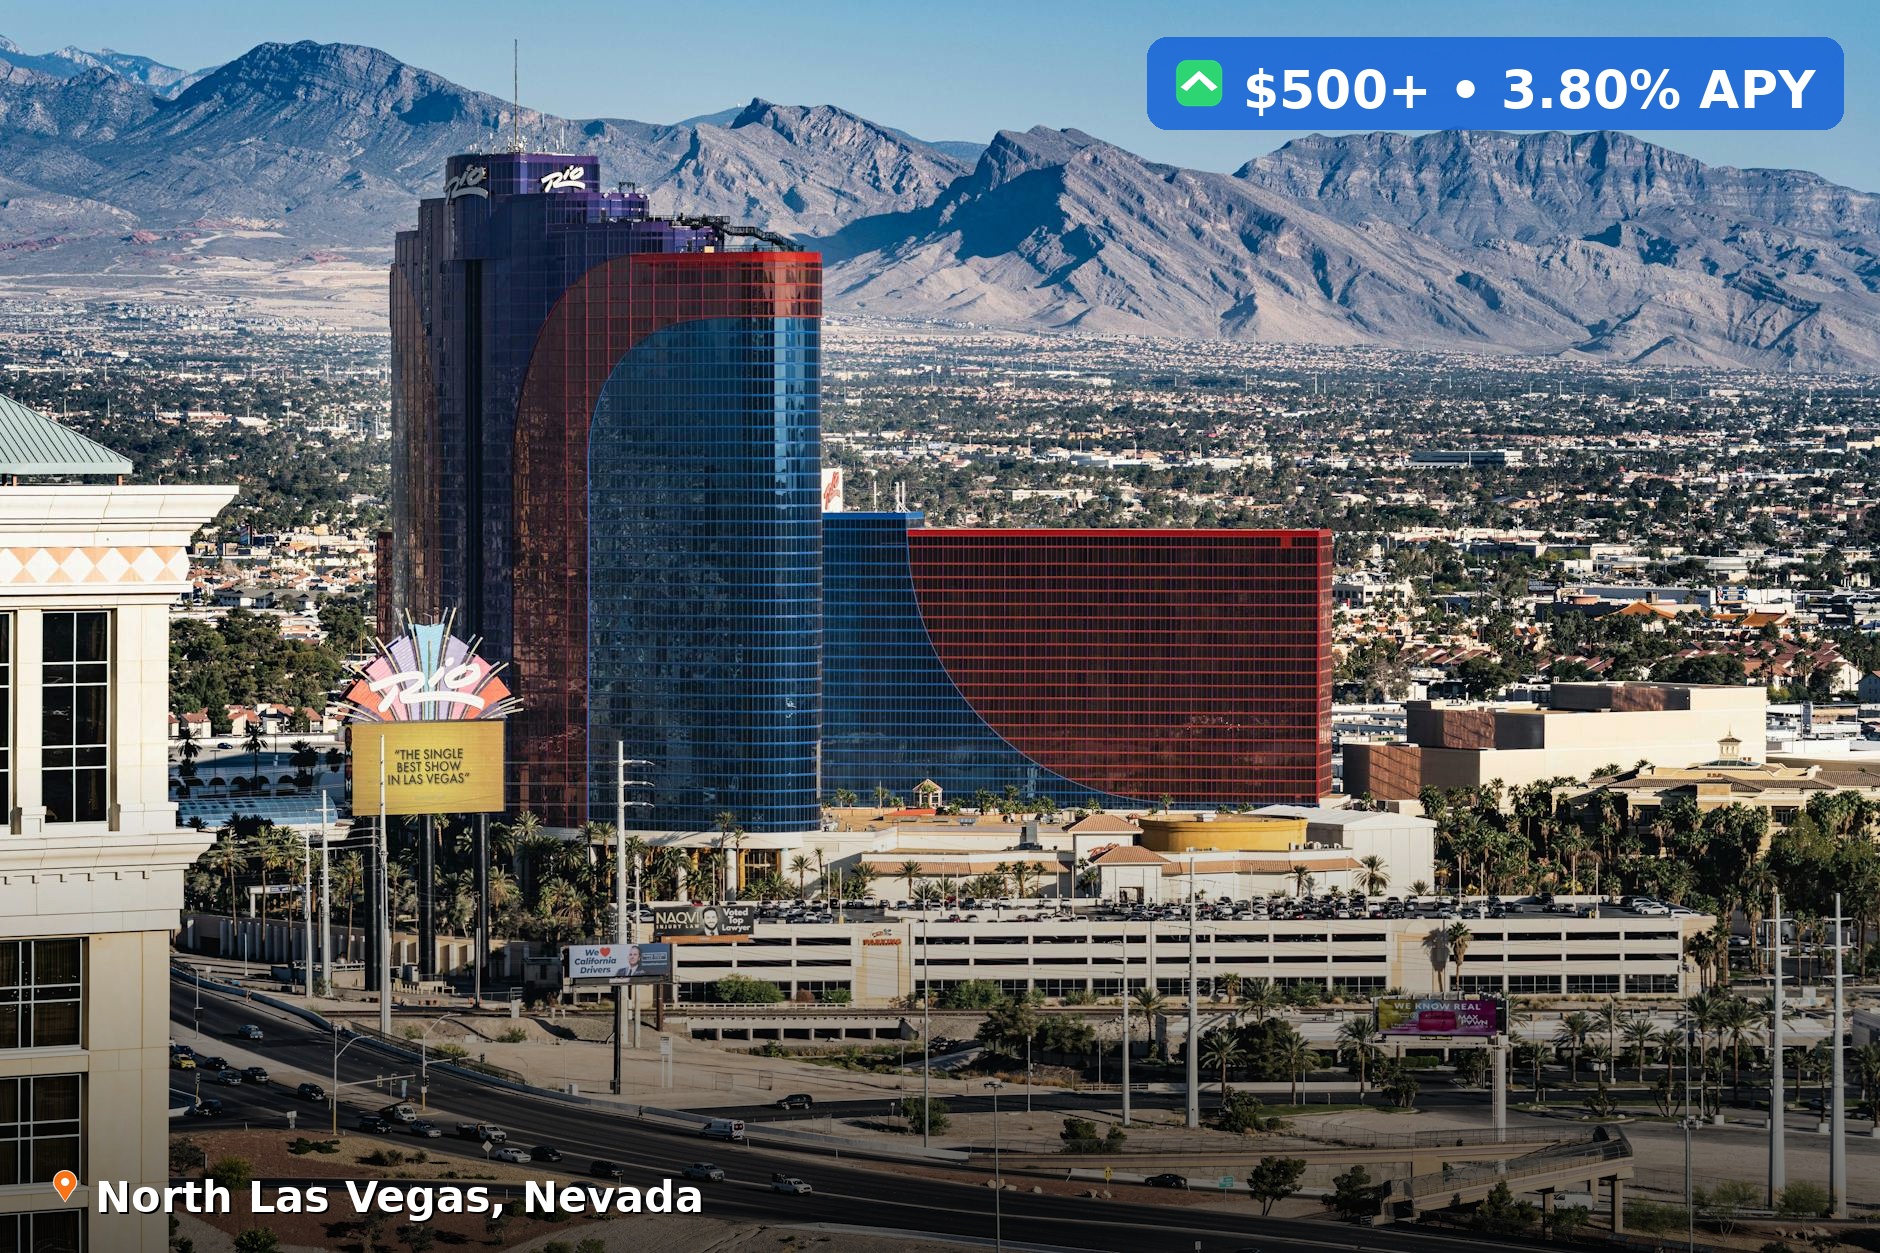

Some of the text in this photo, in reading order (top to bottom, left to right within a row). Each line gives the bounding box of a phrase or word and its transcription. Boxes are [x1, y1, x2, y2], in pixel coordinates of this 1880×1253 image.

[444, 164, 488, 205] Rio
[541, 165, 586, 193] Rio
[368, 656, 485, 713] Rio
[423, 748, 464, 760] SINGLE
[396, 760, 462, 773] BEST SHOW
[387, 774, 400, 785] IN
[403, 774, 423, 785] LAS
[722, 907, 749, 917] Voted
[656, 912, 700, 924] NAQVI
[727, 916, 744, 925] Top
[721, 924, 751, 932] Lawyer
[574, 957, 617, 965] California
[579, 966, 611, 974] Drivers
